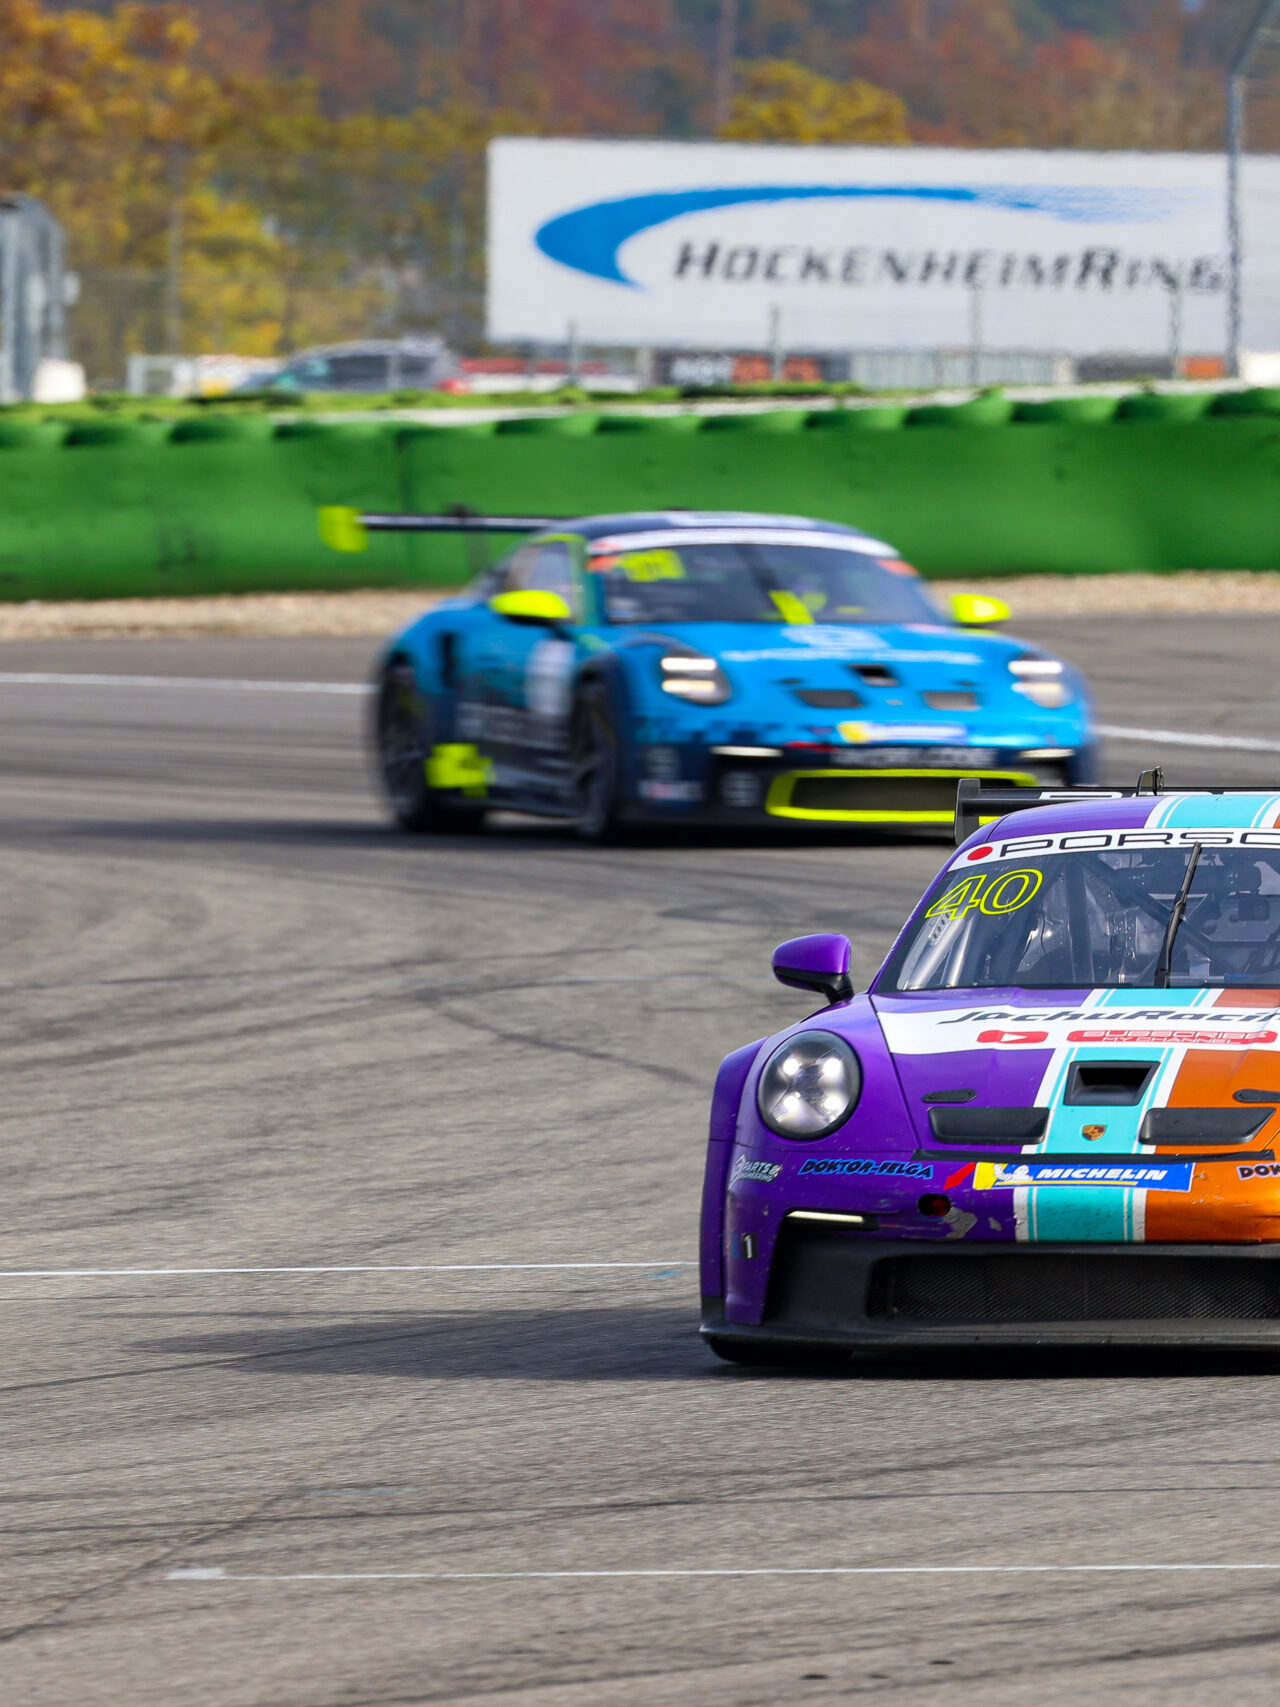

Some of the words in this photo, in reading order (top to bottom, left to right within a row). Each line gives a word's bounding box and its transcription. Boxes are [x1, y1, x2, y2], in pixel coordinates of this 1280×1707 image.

[925, 868, 1043, 921] 40
[1082, 1030, 1268, 1040] SUBSCRIBE
[1135, 1037, 1242, 1045] CHANNEL
[798, 1159, 933, 1179] DOKTOR-FELGA
[1036, 1168, 1168, 1180] MICHELIN
